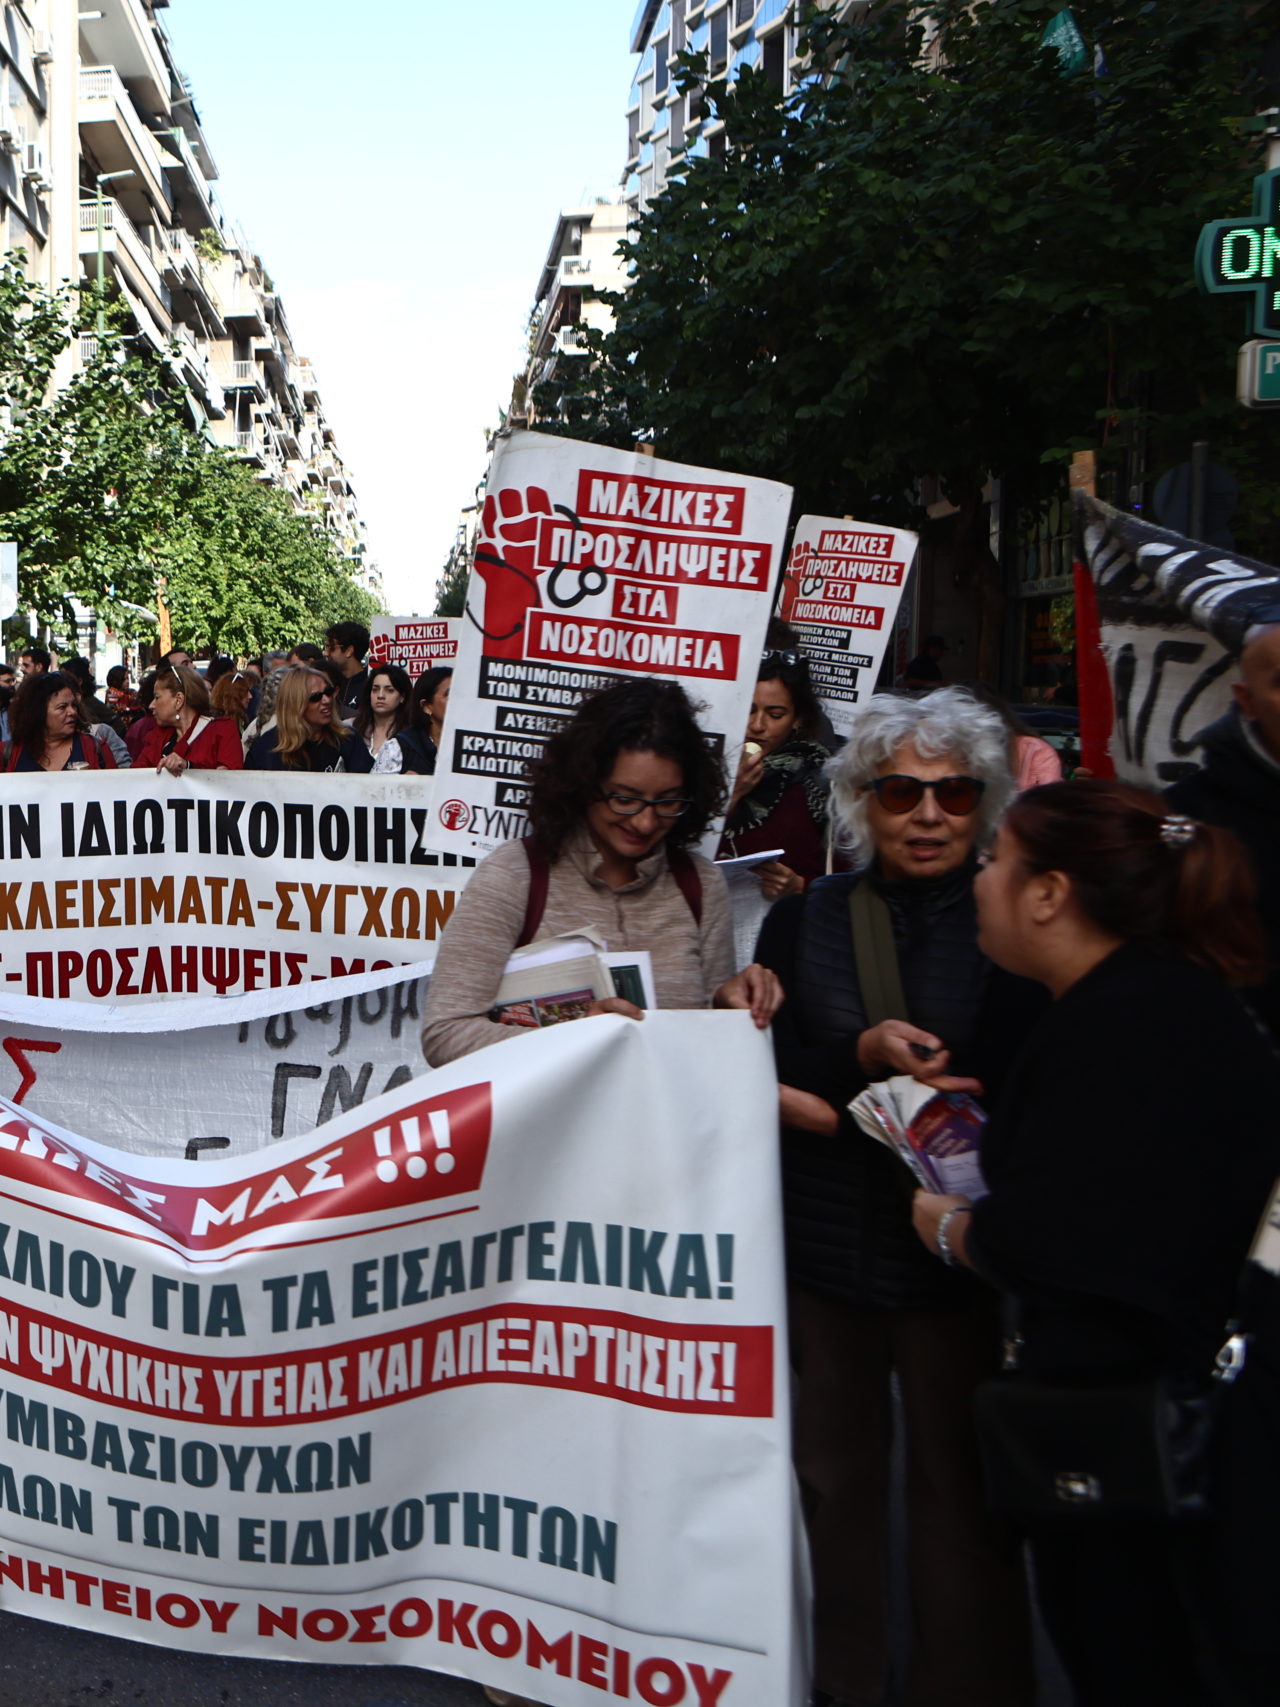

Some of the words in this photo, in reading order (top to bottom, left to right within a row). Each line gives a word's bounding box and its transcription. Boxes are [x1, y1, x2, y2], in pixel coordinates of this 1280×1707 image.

[589, 478, 736, 529] ΜΑΖΙΚΕΣ
[551, 528, 761, 585] ΠΡΟΣΛΗΨΕΙΣ
[822, 534, 889, 555] ΜΑΖΙΚΕΣ
[805, 559, 899, 583] ΠΡΟΣΛΗΨΕΙΣ
[620, 585, 668, 619] ΣΤΑ
[827, 584, 851, 599] ΣΤΑ
[795, 603, 876, 625] ΝΟΣΟΚΟΜΕΙΑ
[398, 625, 445, 640] ΜΑΖΙΚΕΣ
[541, 620, 725, 671] ΝΟΣΟΚΟΜΕΙΑ
[390, 643, 455, 659] ΠΡΟΣΛΗΨΕΙΣ
[488, 662, 617, 689] ΜΟΝΙΜΟΠΟΙΗΣ
[487, 680, 520, 698] ΤΩΝ
[526, 685, 591, 706] ΣΥΜΒΑ
[463, 735, 545, 759] ΚΡΑΤΙΚΟΠ
[461, 754, 533, 776] ΙΔΙΩΤΙΚ
[62, 798, 476, 868] ΙΔΙΩΤΙΚΟΠΟΙΗΣ
[190, 1147, 344, 1236] ΜΑΣ
[373, 1110, 456, 1183] !!!
[152, 1274, 246, 1337] ΓΙΑ
[263, 1270, 335, 1333] ΤΑ
[352, 1221, 734, 1317] ΕΙΣΑΓΓΕΛΙΚΑ!
[29, 1325, 205, 1414] ΨΥΧΙΚΗΣ
[213, 1358, 349, 1418] ΥΓΕΙΑΣ
[358, 1338, 424, 1402] ΚΑΙ
[431, 1318, 736, 1403] ΑΠΕΞΑΡΤΗΣΗΣ!
[108, 1496, 219, 1559] ΤΩΝ
[238, 1492, 617, 1583] ΕΙΔΙΚΟΤΗΤΩΝ
[258, 1597, 734, 1707] ΝΟΣΟΚΟΜΕΙΟΥ
